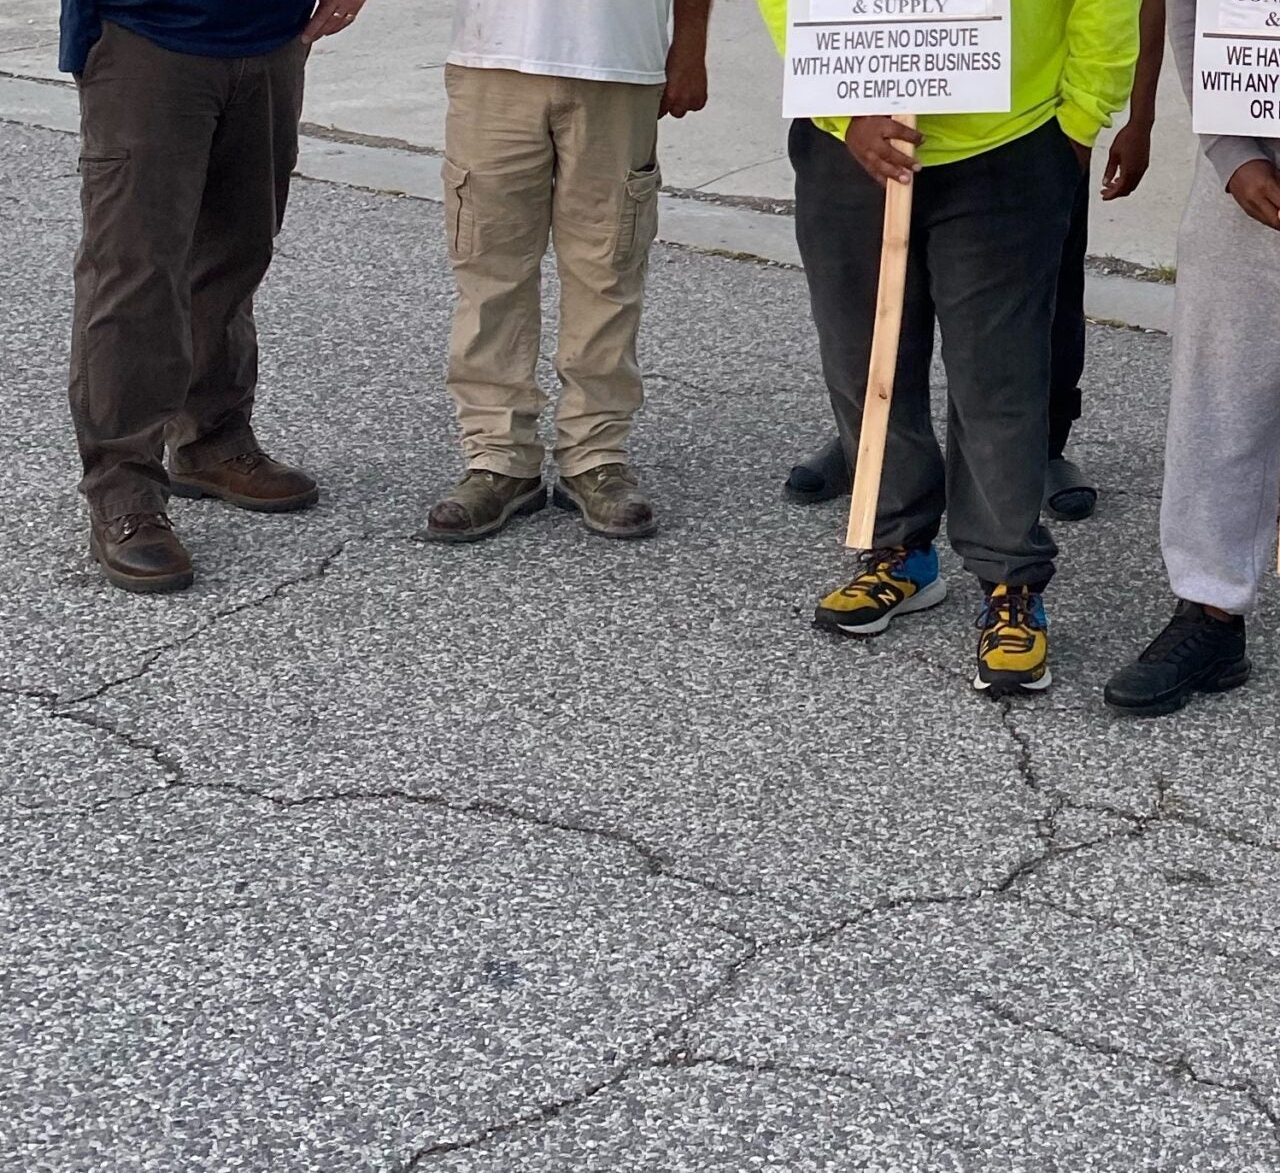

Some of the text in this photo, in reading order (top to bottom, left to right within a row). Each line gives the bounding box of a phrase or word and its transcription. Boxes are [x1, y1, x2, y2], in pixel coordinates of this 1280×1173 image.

[852, 0, 947, 14] & SUPPLY
[1265, 12, 1280, 26] &
[816, 28, 978, 50] WE HAVE NO DISPUTE
[792, 52, 1001, 75] WITH ANY OTHER BUSINESS
[1227, 46, 1252, 66] WE
[837, 78, 951, 99] OR EMPLOYER.
[1202, 71, 1241, 91] WITH
[1245, 73, 1279, 93] ANY
[1251, 100, 1274, 119] OR
